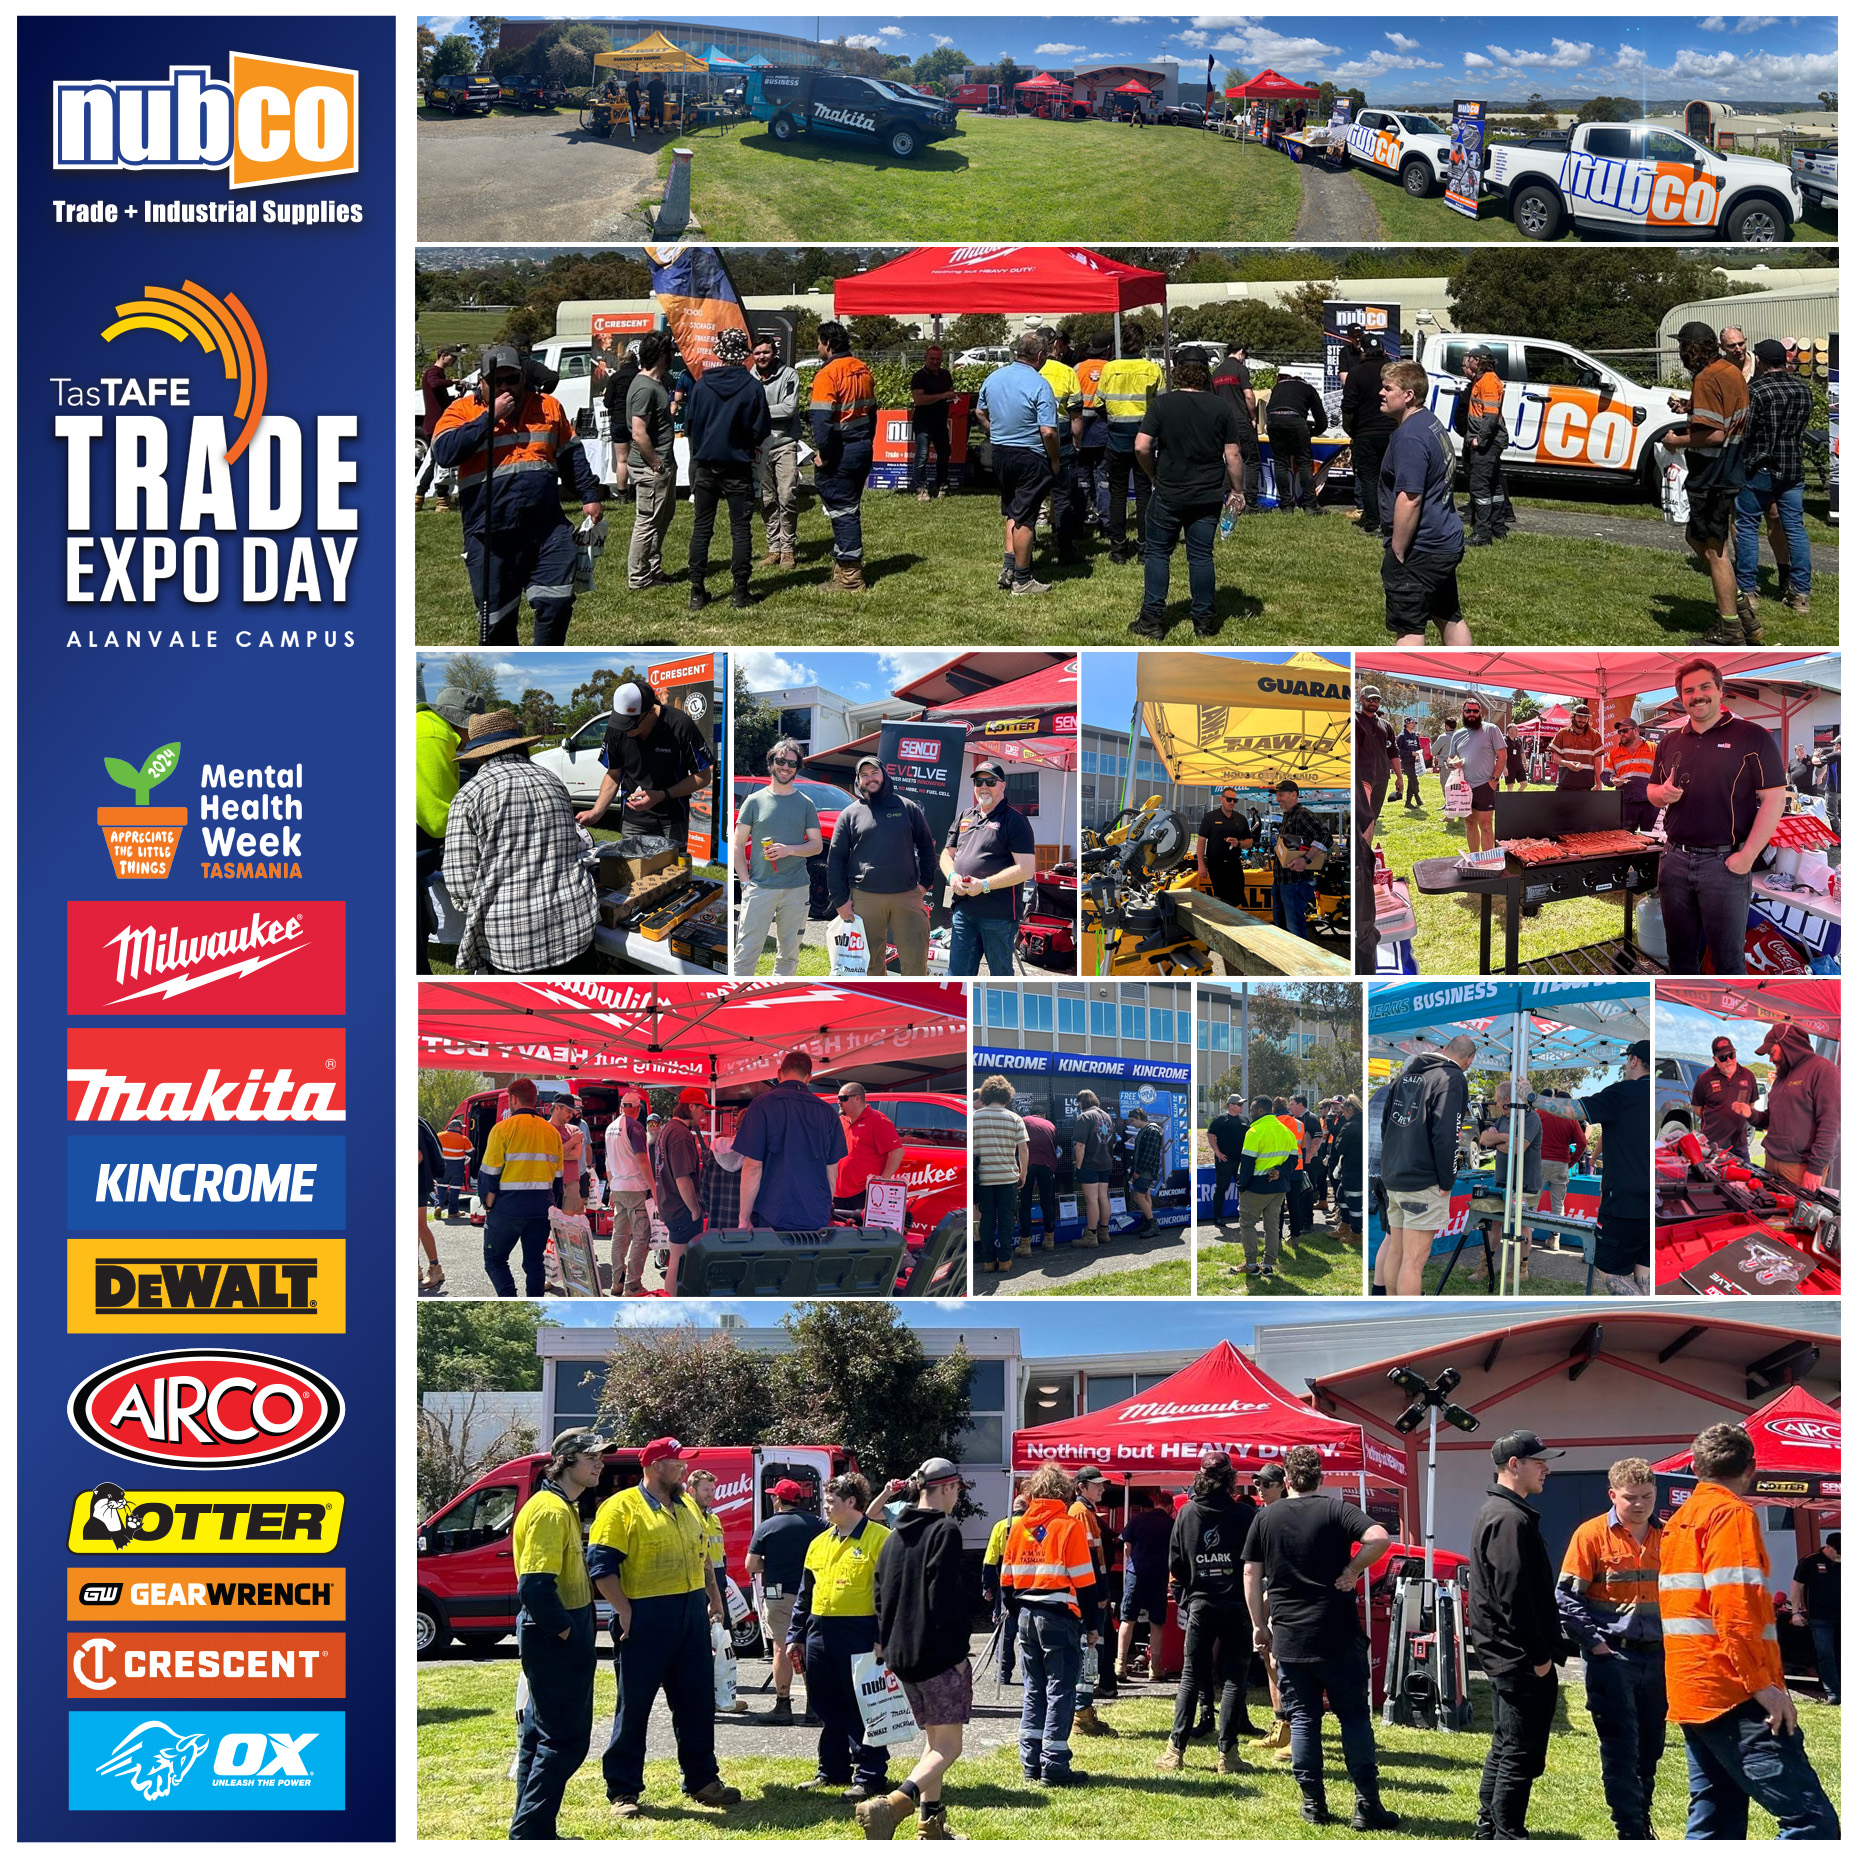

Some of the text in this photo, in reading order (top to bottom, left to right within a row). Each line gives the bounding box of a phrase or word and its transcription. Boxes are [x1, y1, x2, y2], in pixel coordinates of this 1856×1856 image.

[1347, 122, 1400, 169] nubco
[1559, 151, 1717, 226] nubco
[605, 319, 649, 329] CRESCENT
[689, 322, 716, 331] STORAGE
[1336, 309, 1388, 327] nubco
[660, 664, 706, 681] CRESCENT
[901, 741, 938, 756] SENCO
[1413, 982, 1499, 1011] BUSINESS
[1058, 1058, 1125, 1075] KINCROME
[1132, 1064, 1189, 1080] KINCROME
[1402, 1075, 1423, 1085] SALTY
[1120, 1092, 1136, 1100] FREE
[1158, 1187, 1187, 1197] KINCROME
[1826, 1224, 1837, 1249] SENCO
[1118, 1400, 1271, 1421] Milwaukee
[1027, 1443, 1111, 1463] Nothing
[1117, 1444, 1155, 1459] but
[1160, 1443, 1254, 1458] HEAVY
[1195, 1553, 1232, 1564] CLARK
[861, 1673, 897, 1697] nubc
